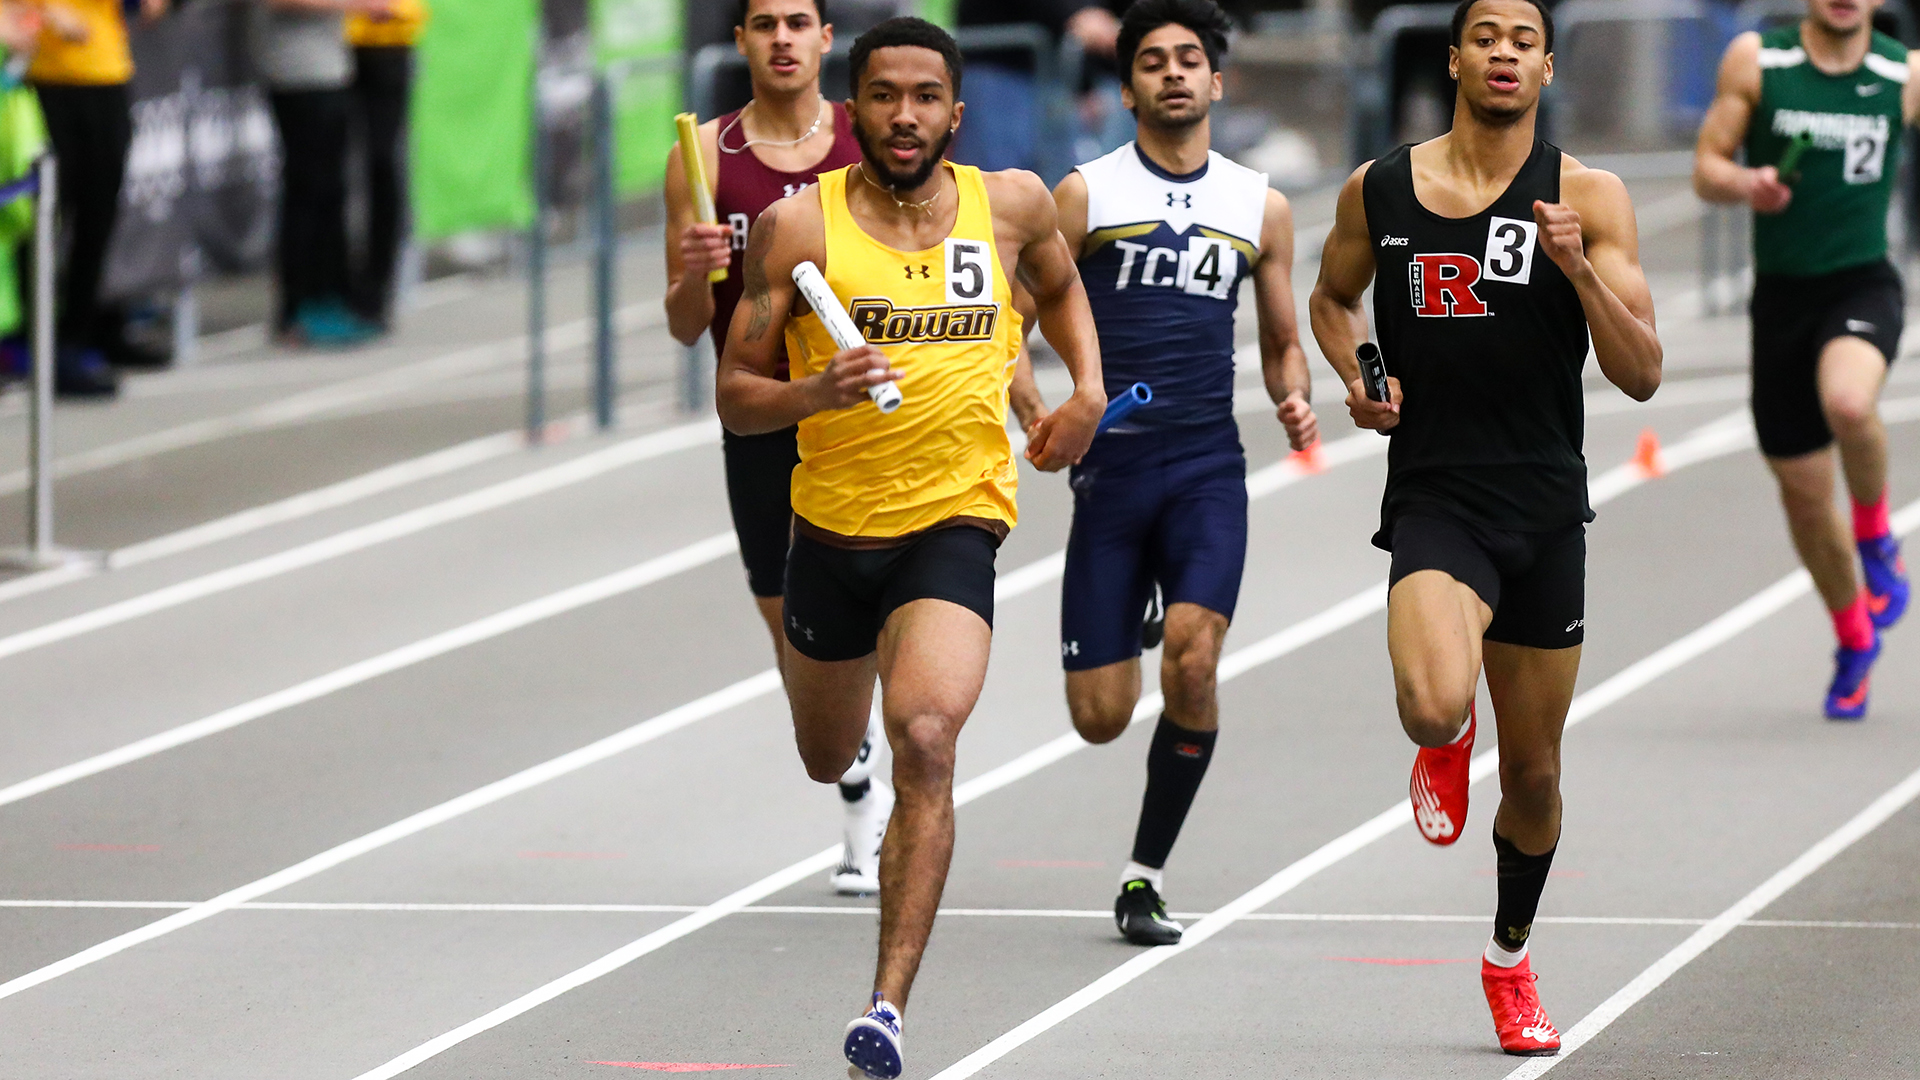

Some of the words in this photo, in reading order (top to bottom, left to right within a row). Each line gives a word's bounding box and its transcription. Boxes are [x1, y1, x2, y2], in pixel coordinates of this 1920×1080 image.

[1854, 134, 1876, 175] 2
[1388, 236, 1410, 247] asics
[1489, 222, 1527, 278] 3
[951, 243, 985, 299] 5
[1193, 243, 1221, 291] 4
[1412, 265, 1422, 305] NEWARK
[1413, 253, 1487, 317] R
[851, 297, 999, 345] Rowan
